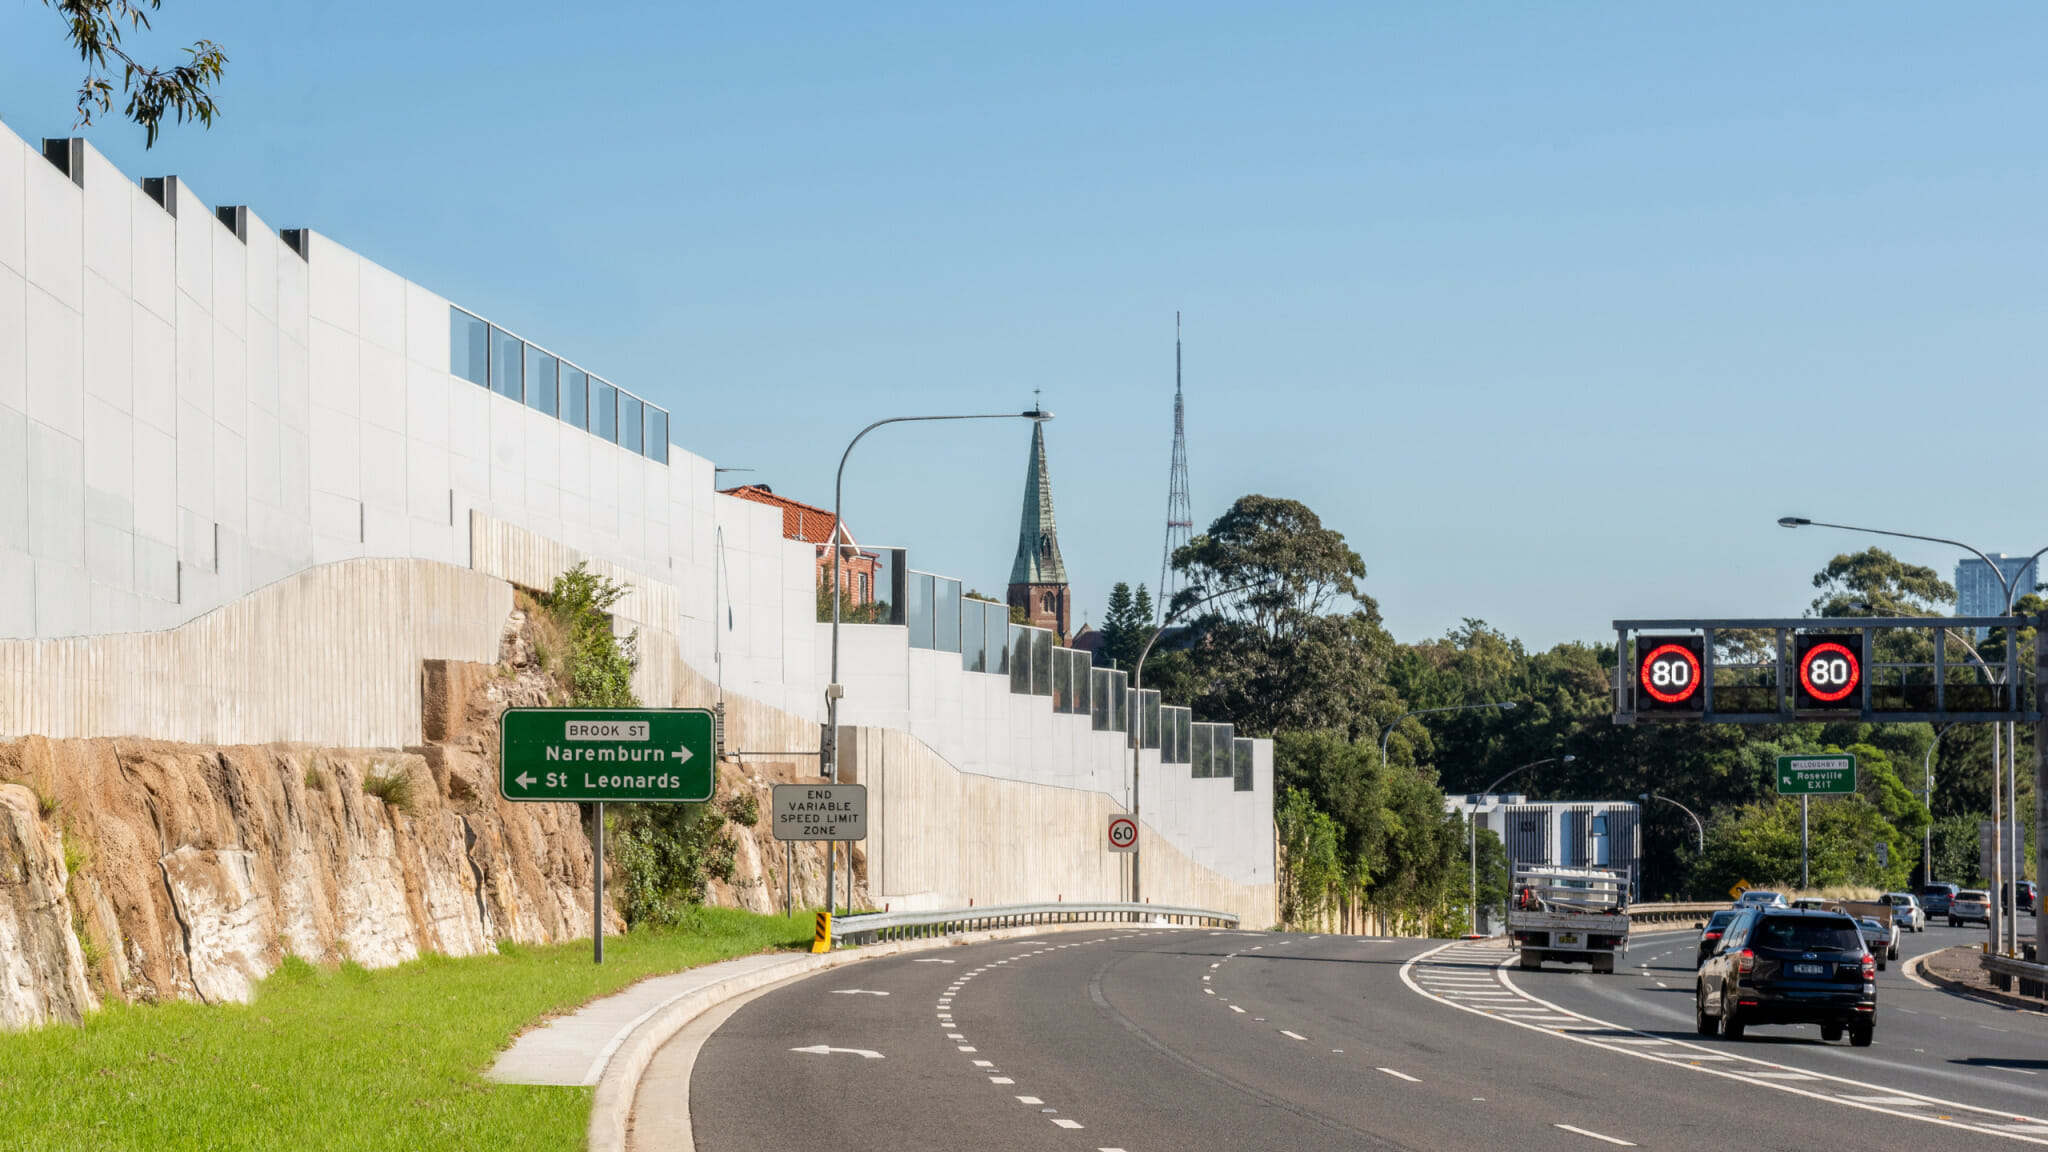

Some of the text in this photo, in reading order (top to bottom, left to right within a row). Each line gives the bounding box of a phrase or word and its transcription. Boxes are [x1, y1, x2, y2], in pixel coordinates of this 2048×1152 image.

[1653, 661, 1688, 686] 80
[1811, 659, 1848, 684] 80
[569, 725, 645, 737] BROOK ST
[546, 745, 665, 762] Naremburn
[545, 772, 681, 789] St Leonards
[1797, 772, 1842, 780] Roseville
[1808, 780, 1831, 789] EXIT
[807, 790, 832, 799] END
[788, 802, 851, 811] VARIABLE
[780, 814, 859, 823] SPEED LIMIT
[803, 826, 836, 835] ZONE
[1113, 826, 1133, 840] 60
